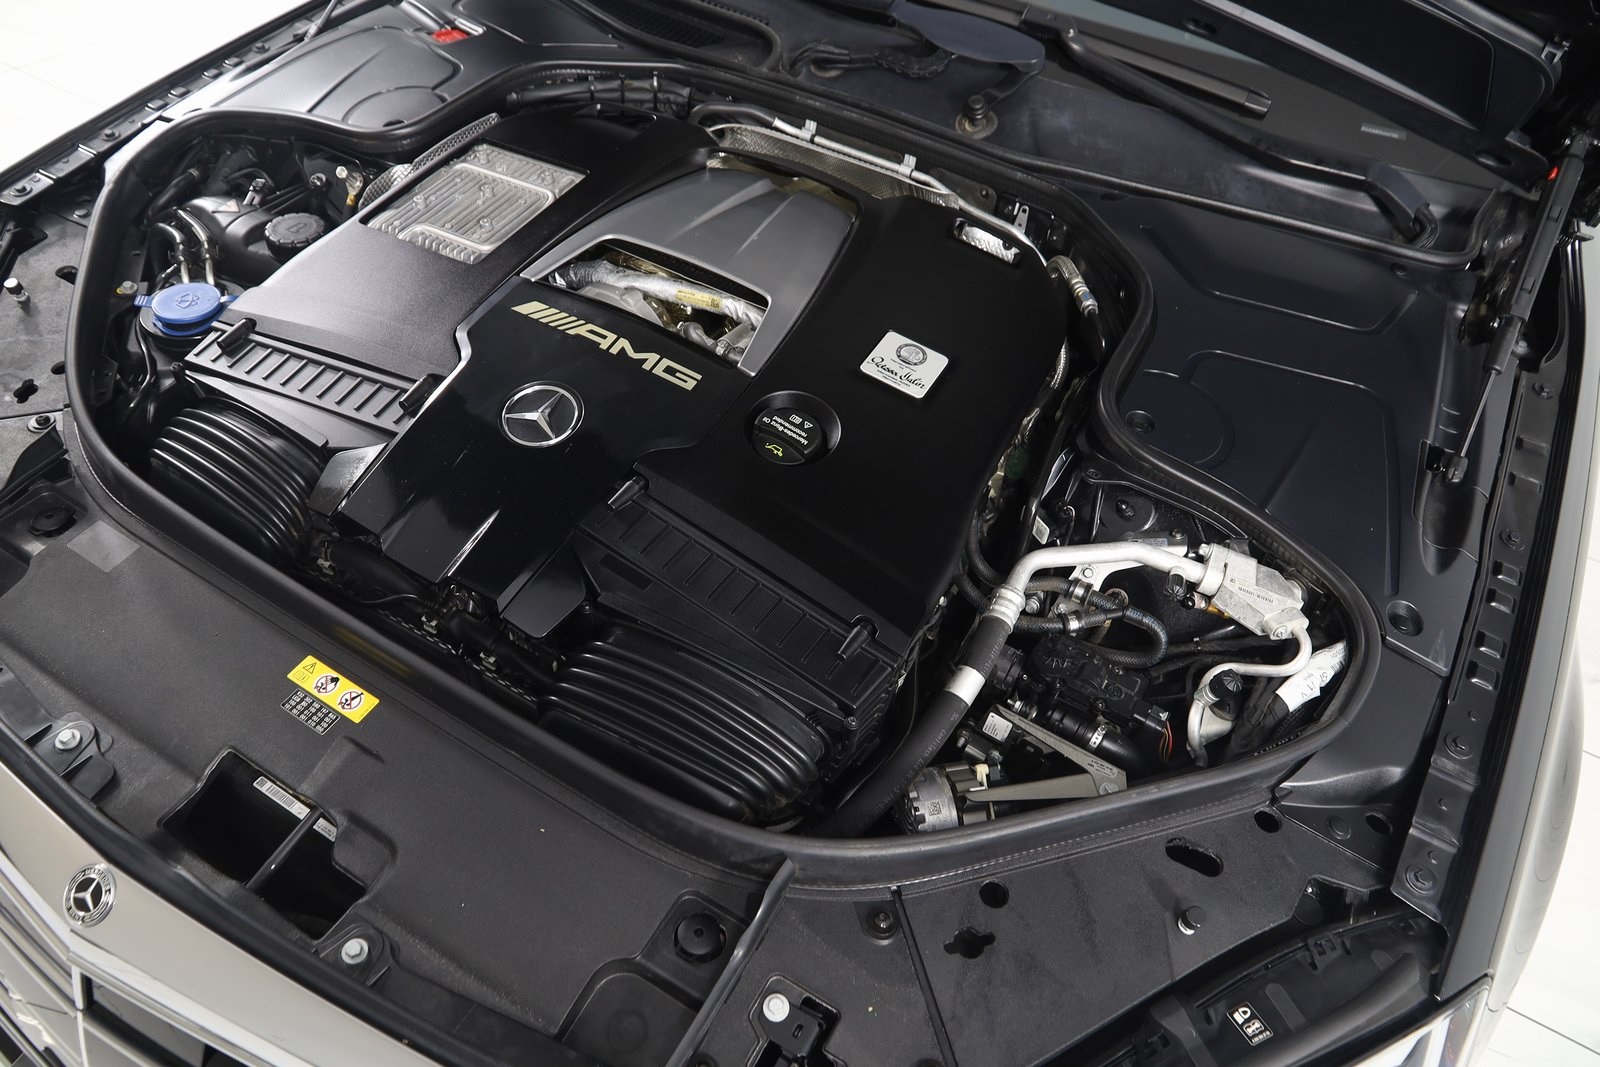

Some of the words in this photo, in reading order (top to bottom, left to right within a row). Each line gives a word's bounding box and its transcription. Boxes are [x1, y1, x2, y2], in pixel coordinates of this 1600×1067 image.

[568, 321, 703, 391] AMG
[770, 420, 809, 446] Mercedes-Benz
[772, 415, 808, 438] recommended
